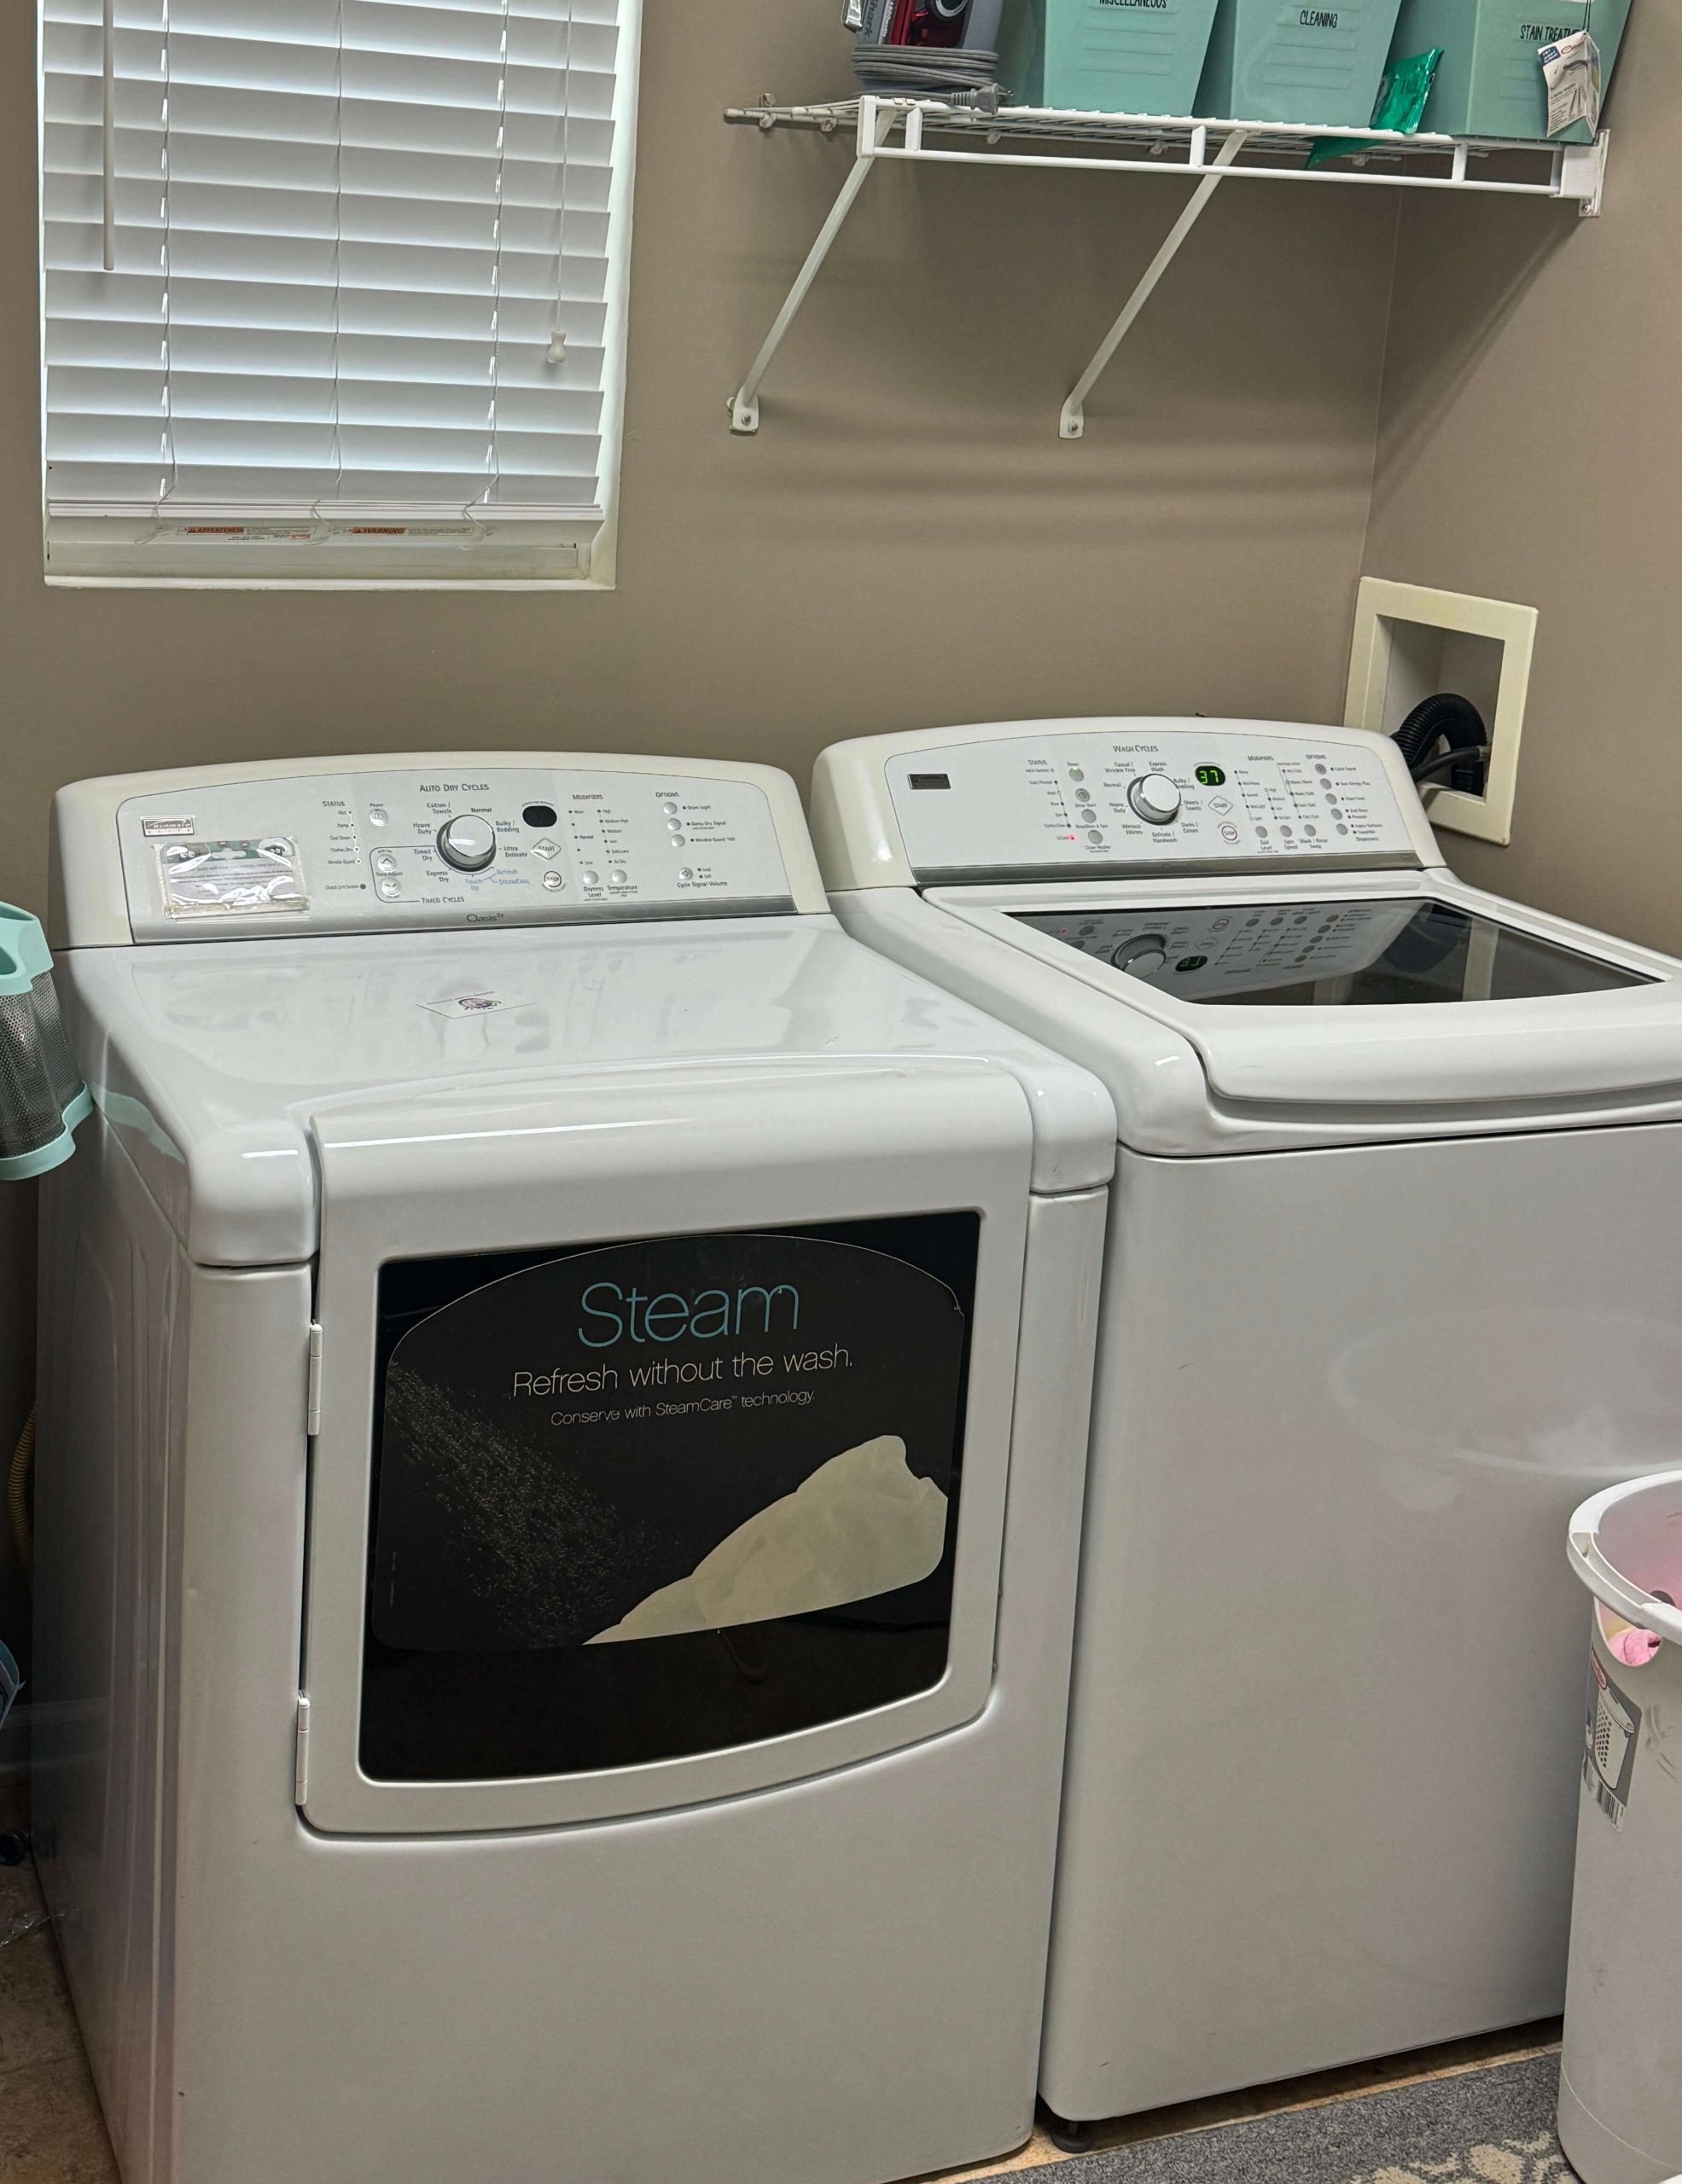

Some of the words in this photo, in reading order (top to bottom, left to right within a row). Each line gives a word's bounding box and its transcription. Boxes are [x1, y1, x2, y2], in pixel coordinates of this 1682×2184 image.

[1300, 9, 1337, 28] CLEANING
[1520, 25, 1543, 41] STAIN
[1545, 26, 1583, 42] TREAT
[1198, 770, 1219, 784] 37
[461, 783, 490, 792] CYCLES
[577, 1281, 800, 1348] Steam
[512, 1363, 619, 1398] Refresh
[629, 1356, 723, 1387] without
[731, 1350, 774, 1379] the
[783, 1343, 853, 1373] wash.
[550, 1409, 620, 1426] Conserve
[624, 1404, 651, 1420] with
[741, 1389, 815, 1409] technology.
